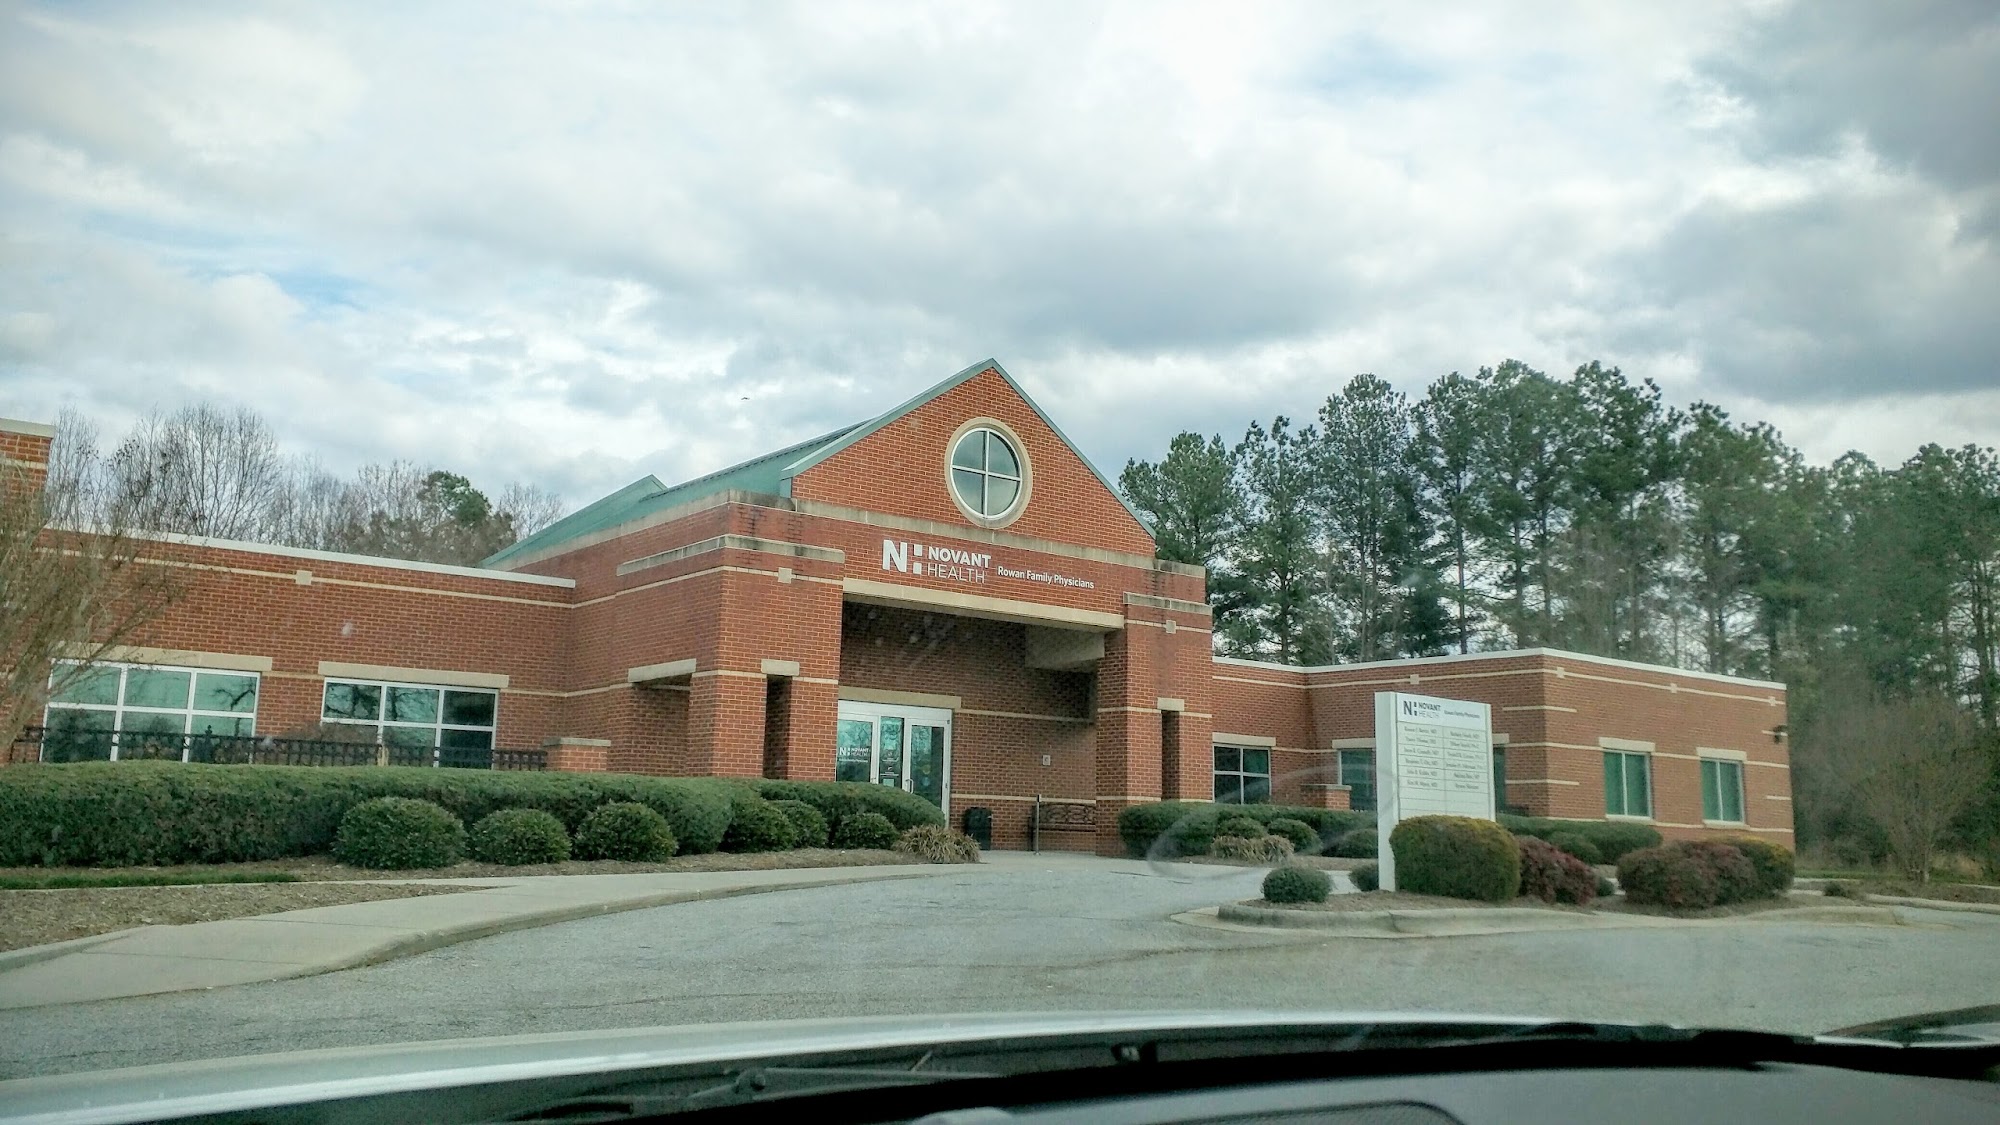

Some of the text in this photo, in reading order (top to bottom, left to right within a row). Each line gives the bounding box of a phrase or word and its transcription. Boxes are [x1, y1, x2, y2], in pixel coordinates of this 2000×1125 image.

[928, 546, 992, 569] NOVANT
[927, 563, 986, 584] HEALTH
[997, 565, 1095, 590] Rowan Family Physicians
[1418, 702, 1441, 712] NOVANT
